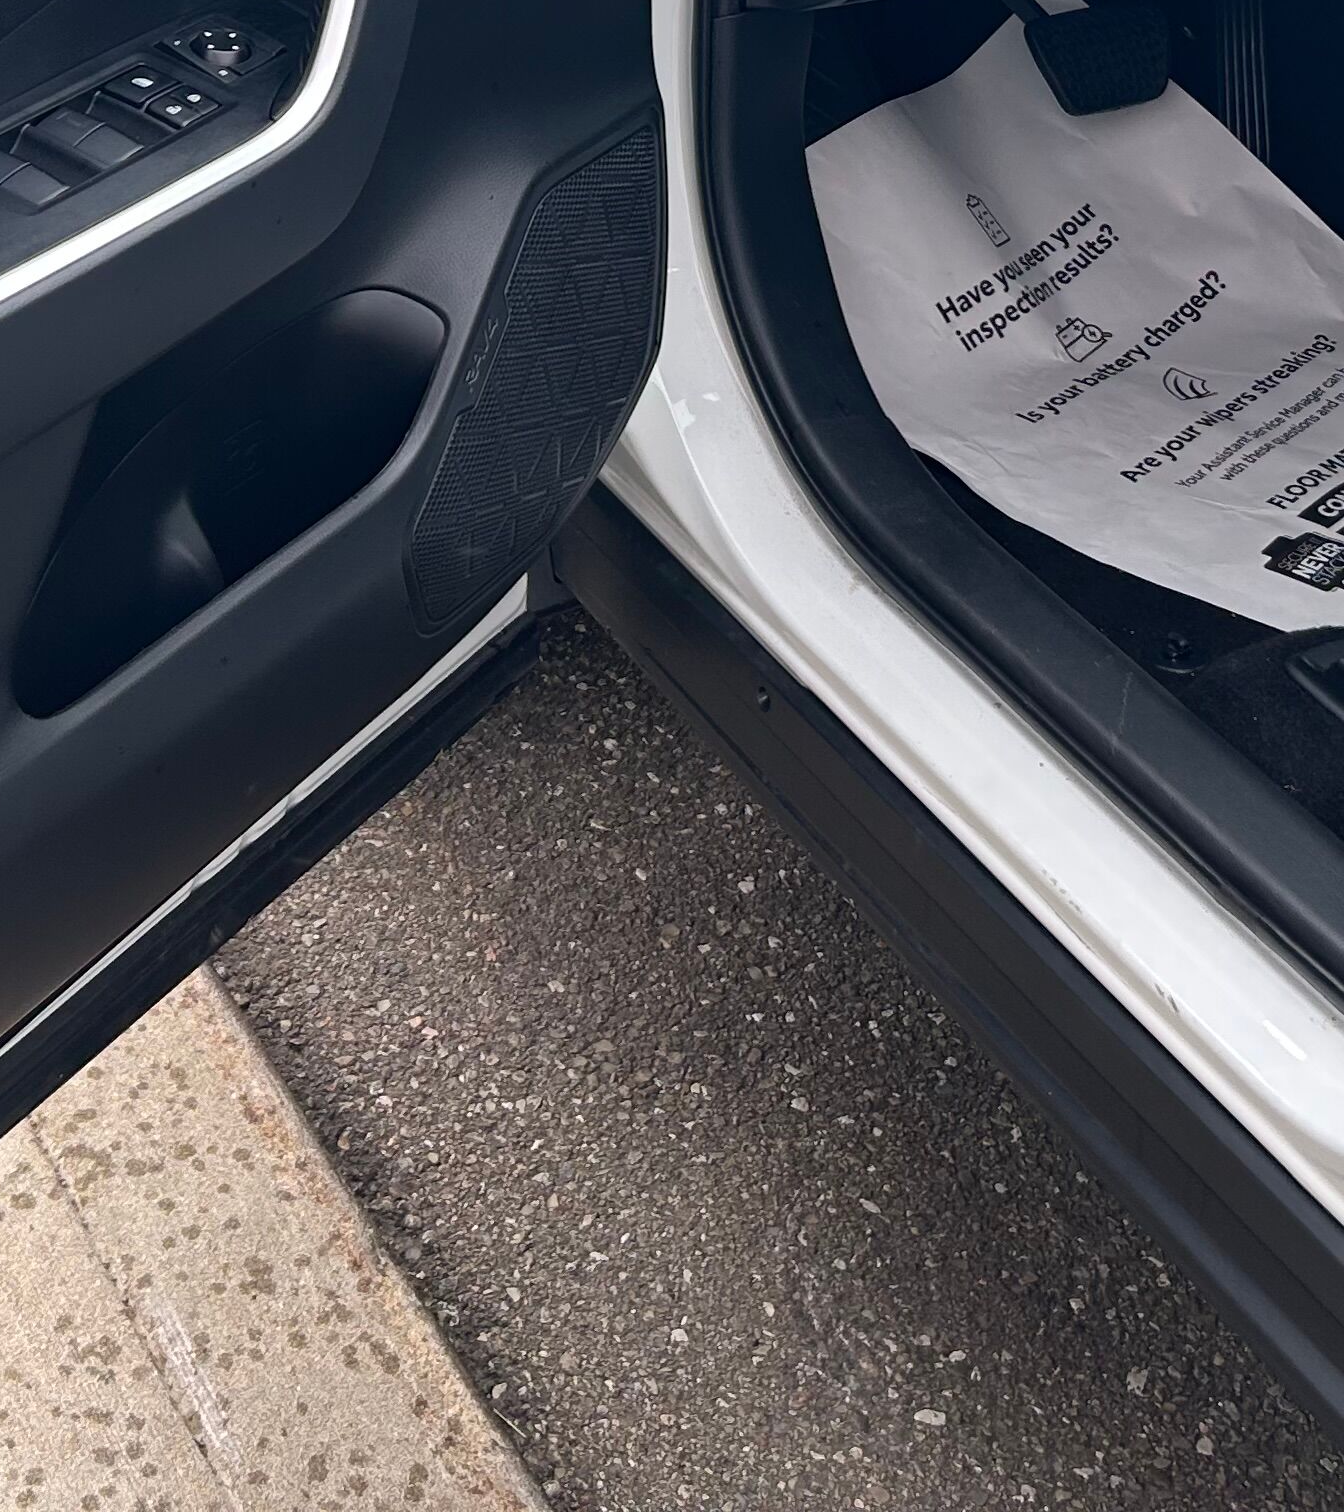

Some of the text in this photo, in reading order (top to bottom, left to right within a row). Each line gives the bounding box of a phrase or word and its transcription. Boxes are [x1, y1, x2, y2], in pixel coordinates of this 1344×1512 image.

[935, 203, 1097, 324] Have you seen your
[955, 223, 1120, 352] inspection results?
[1015, 270, 1226, 424] Is your battery charged?
[1120, 334, 1338, 483] Are your wipers streaking?
[1174, 469, 1207, 489] Your
[1205, 430, 1253, 472] Assistant
[1244, 411, 1287, 439] Service
[1278, 387, 1326, 420] Manager
[1321, 372, 1342, 389] can
[1220, 460, 1250, 482] with
[1243, 441, 1277, 465] these
[1273, 413, 1322, 447] questions
[1317, 398, 1340, 417] and
[1265, 468, 1331, 510] FLOOR
